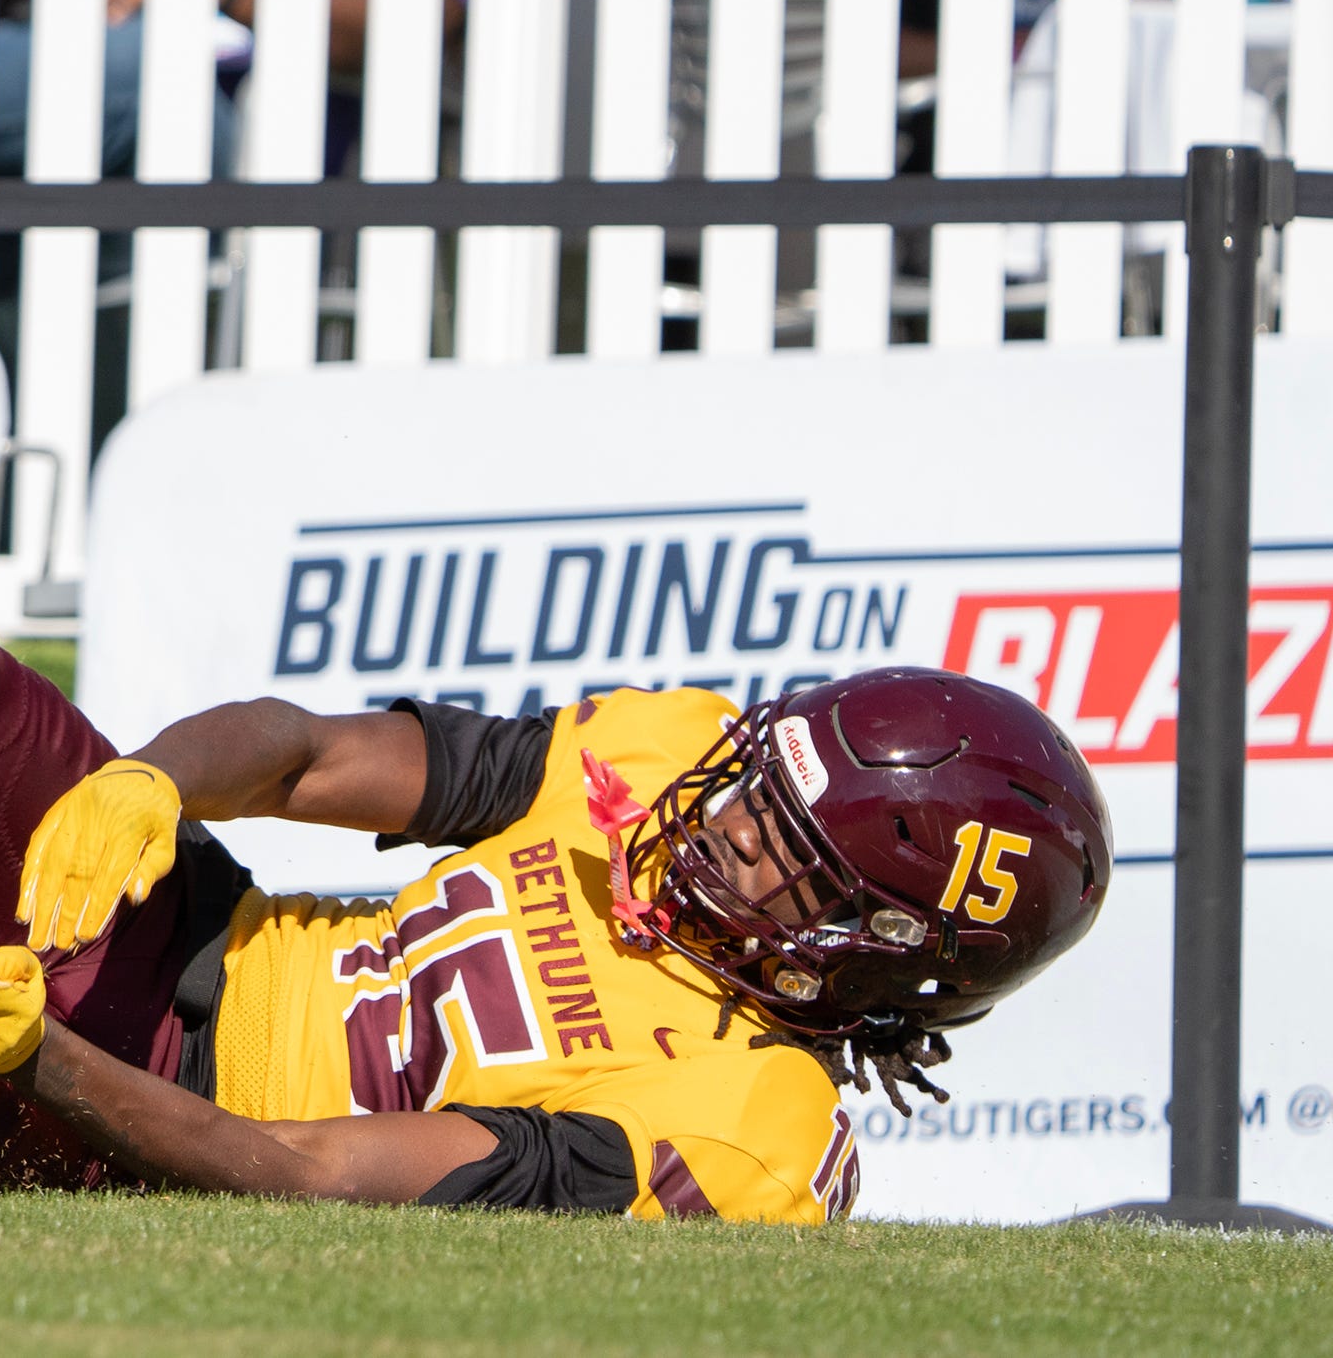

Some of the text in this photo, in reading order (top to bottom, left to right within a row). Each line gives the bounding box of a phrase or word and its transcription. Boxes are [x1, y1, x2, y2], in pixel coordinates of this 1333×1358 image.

[273, 538, 909, 676] BUILDING ON
[963, 599, 1333, 752] BLAZ
[509, 837, 614, 1059] BETHUNE
[938, 820, 1032, 925] 15
[332, 862, 549, 1115] 15
